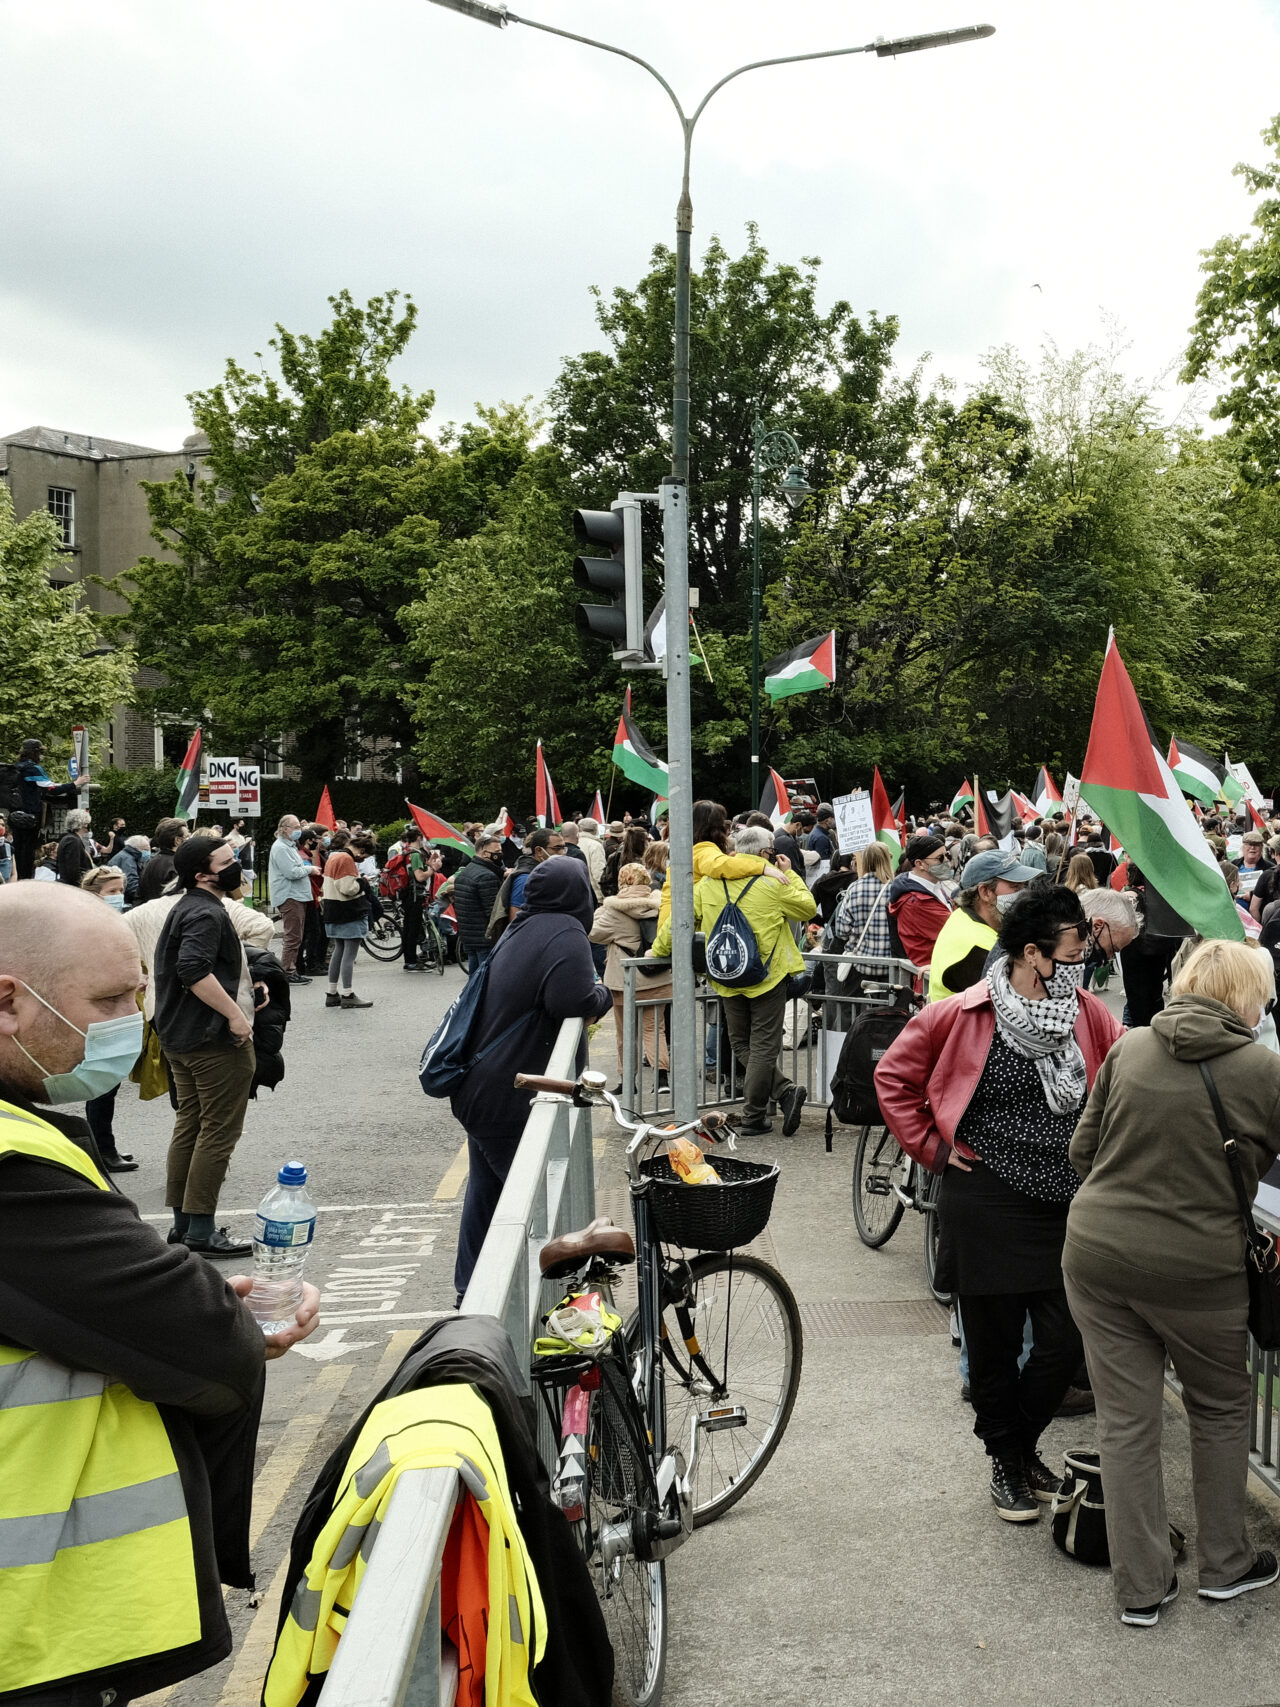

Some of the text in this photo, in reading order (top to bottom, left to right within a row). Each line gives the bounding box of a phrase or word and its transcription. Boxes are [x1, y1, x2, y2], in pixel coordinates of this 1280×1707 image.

[209, 762, 237, 778] DNG
[239, 771, 258, 786] NG
[318, 1211, 453, 1317] LOOK LEFT
